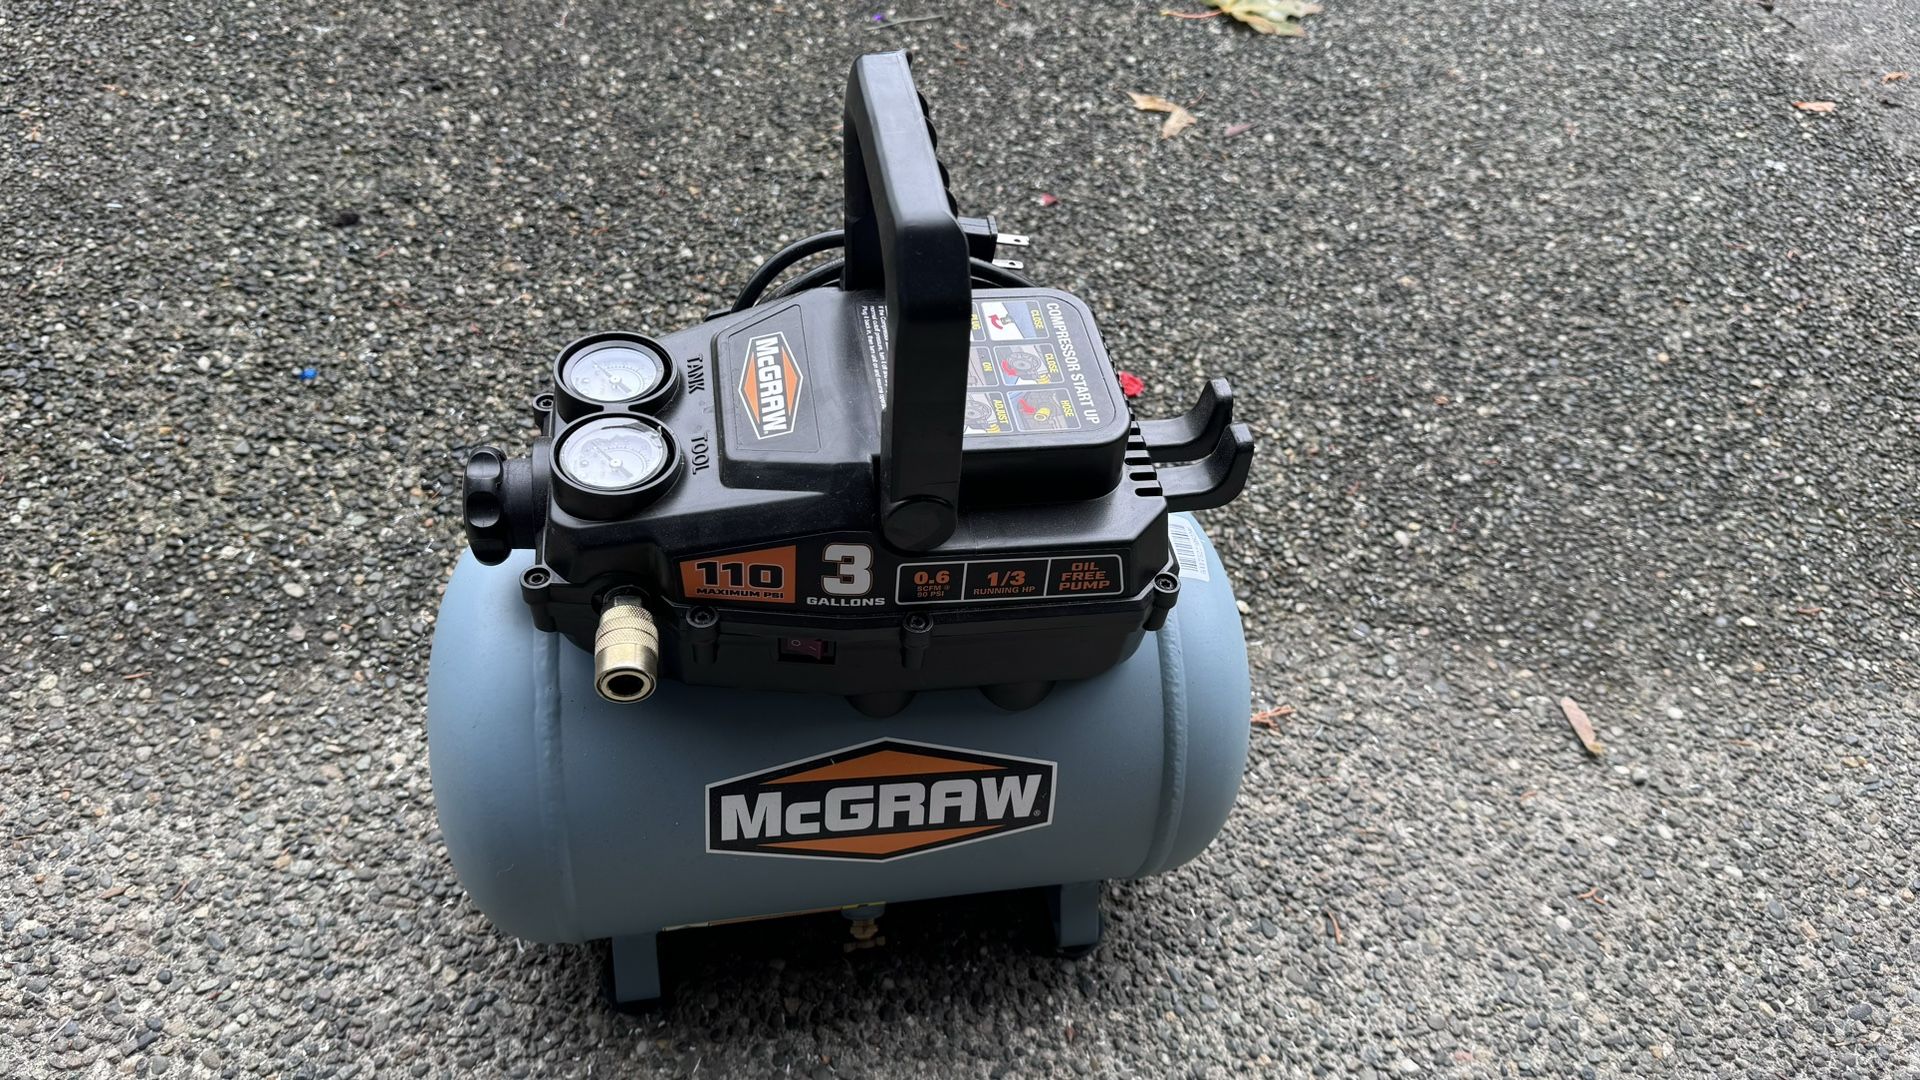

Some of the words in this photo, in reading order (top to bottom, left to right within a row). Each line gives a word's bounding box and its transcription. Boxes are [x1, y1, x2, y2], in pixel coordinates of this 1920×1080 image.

[1030, 309, 1044, 330] CLOSE
[982, 361, 993, 372] ON
[1044, 352, 1059, 373] CLOSE
[1046, 303, 1080, 372] COMPRESSOR
[1071, 373, 1094, 406] START
[1083, 408, 1100, 425] UP
[687, 353, 705, 395] TANK
[992, 399, 1009, 424] ADJUST
[1060, 399, 1075, 417] HOSE
[691, 432, 710, 476] TOOL
[695, 560, 784, 589] 110
[821, 542, 874, 597] 3
[1071, 562, 1100, 571] OIL
[914, 570, 950, 585] 0.6
[987, 570, 1026, 587] 1/3
[1061, 571, 1106, 581] FREE
[696, 588, 760, 598] MAXIMUM
[973, 587, 1019, 596] RUNNING
[1021, 586, 1036, 594] HP
[1058, 580, 1111, 591] PUMP
[806, 597, 886, 606] GALLONS
